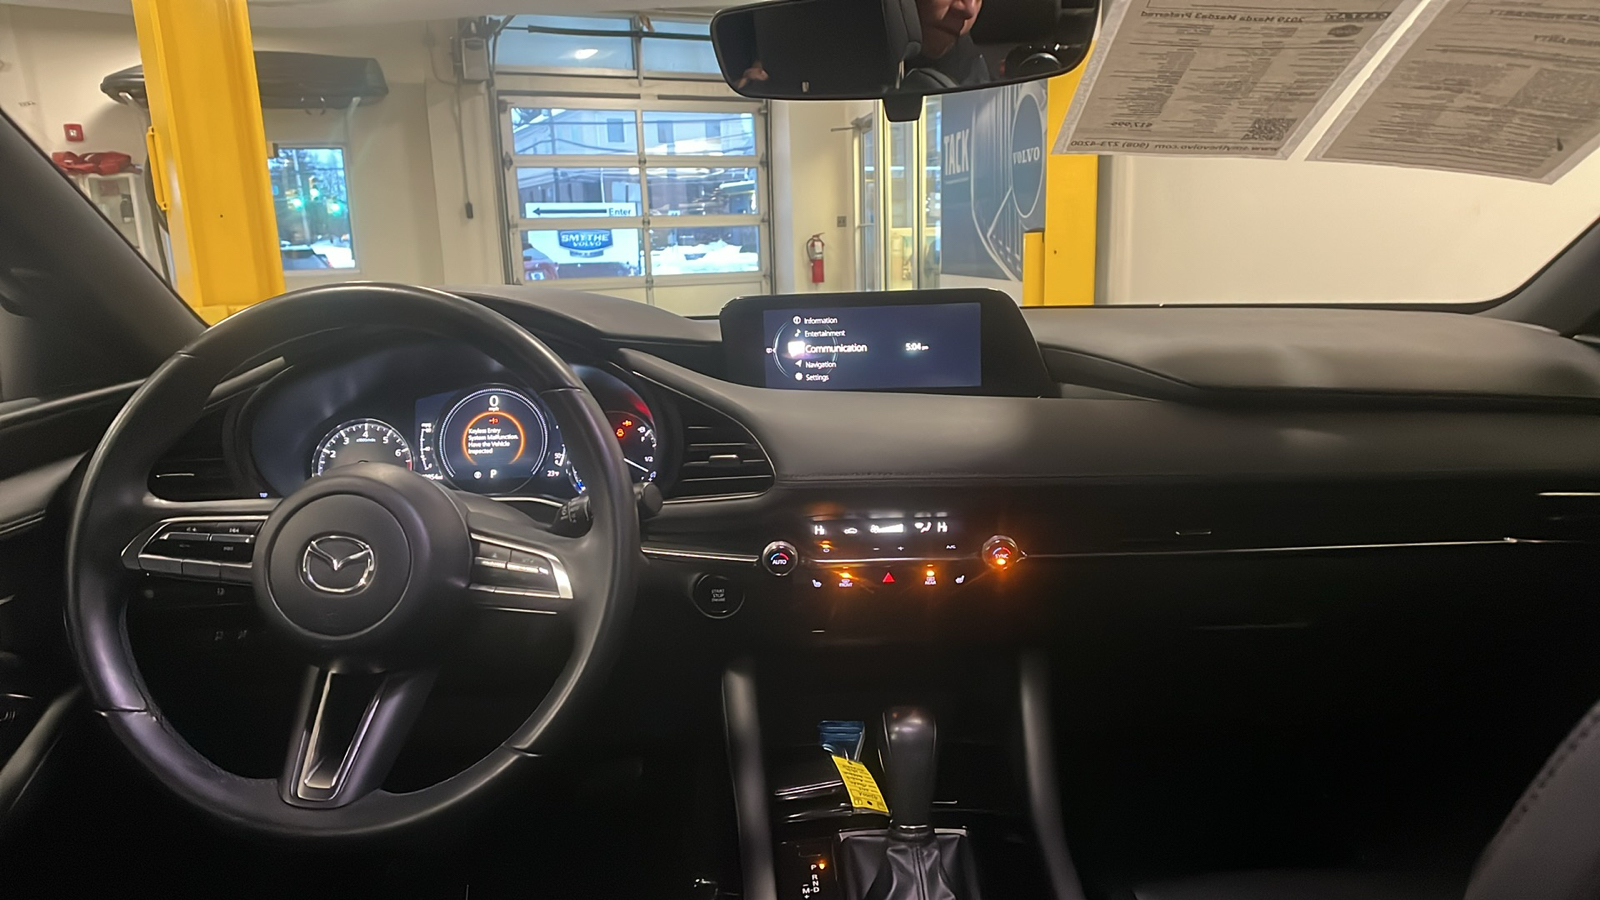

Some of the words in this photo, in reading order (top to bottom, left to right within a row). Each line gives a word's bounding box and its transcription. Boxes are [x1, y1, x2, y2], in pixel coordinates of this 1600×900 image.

[943, 129, 970, 176] TACK
[1012, 146, 1041, 165] VOLVO
[608, 207, 632, 216] Enter
[561, 233, 609, 242] SMYTHE
[803, 316, 838, 324] Information
[805, 343, 868, 353] Communication
[905, 342, 922, 351] 5:04
[805, 361, 837, 369] Navigation
[805, 374, 830, 382] Settings
[489, 395, 499, 407] 0
[343, 437, 350, 445] 3
[329, 450, 336, 458] 2
[395, 449, 401, 457] 6
[490, 469, 498, 478] P
